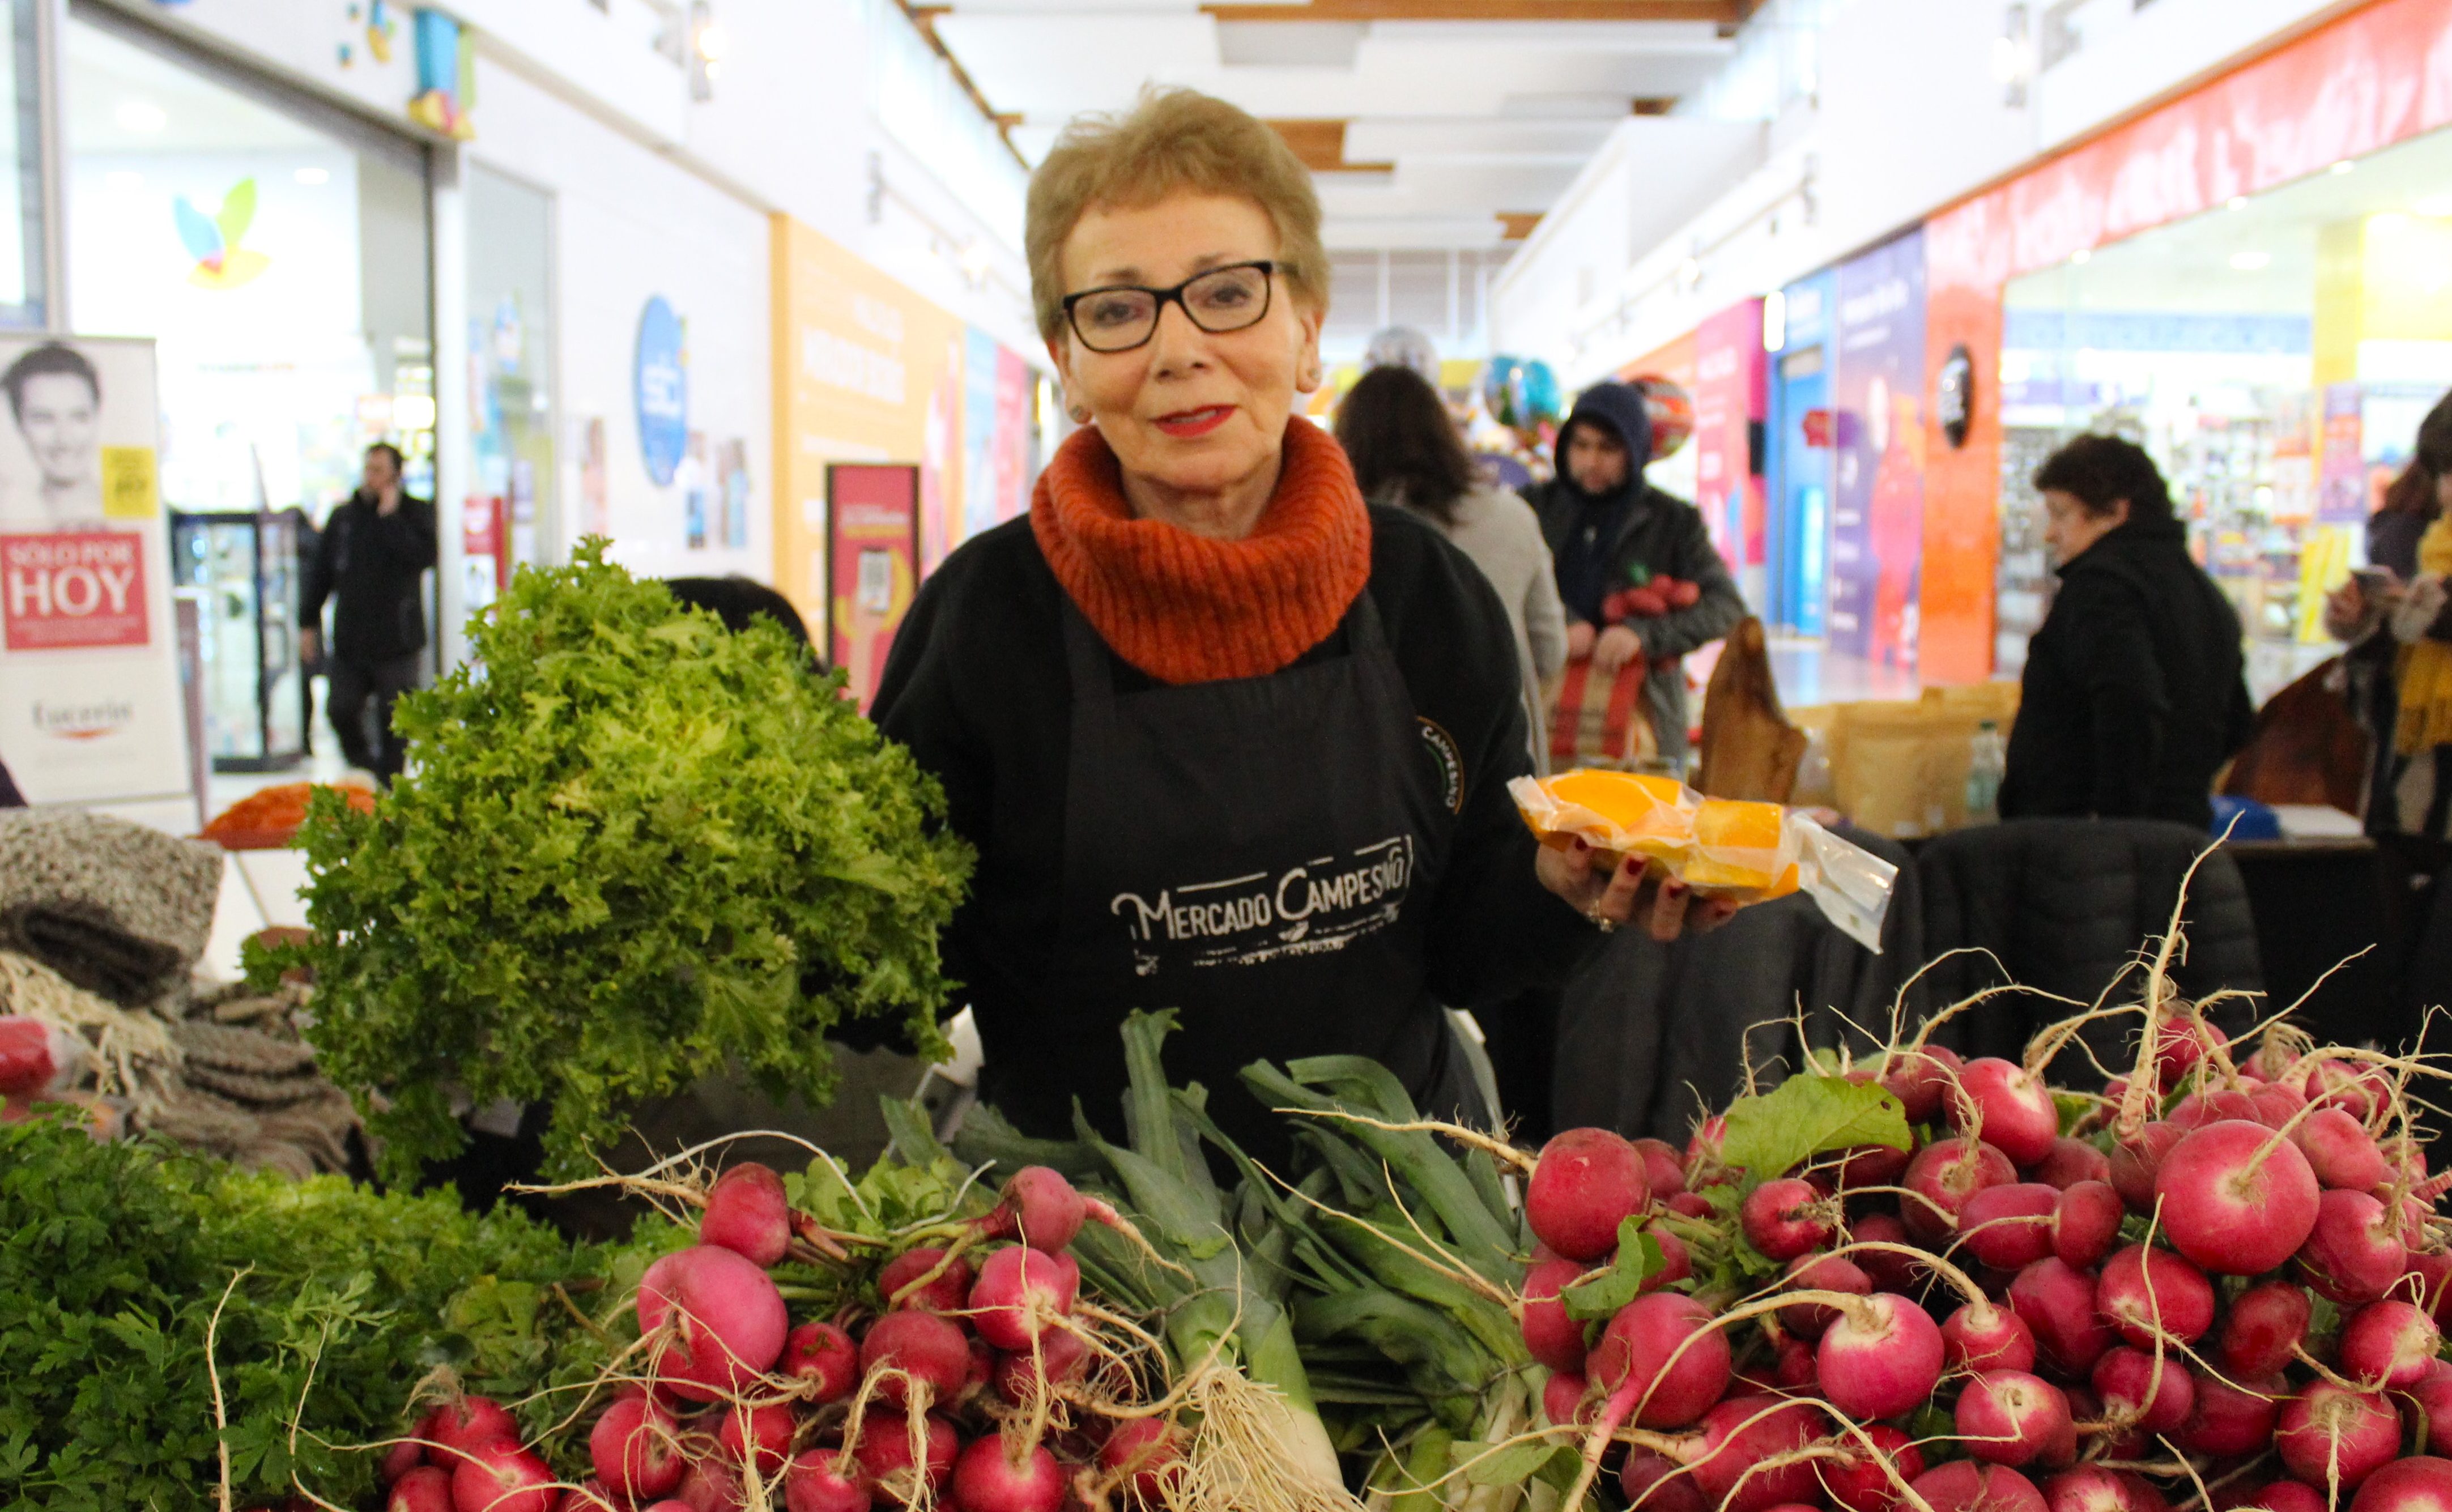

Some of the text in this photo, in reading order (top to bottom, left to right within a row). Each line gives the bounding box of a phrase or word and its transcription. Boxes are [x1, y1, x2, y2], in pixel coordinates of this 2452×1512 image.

[11, 568, 134, 615] HOY
[1421, 726, 1458, 808] CAMPESINO
[1111, 846, 1406, 940] MERCADO CAMPESNO
